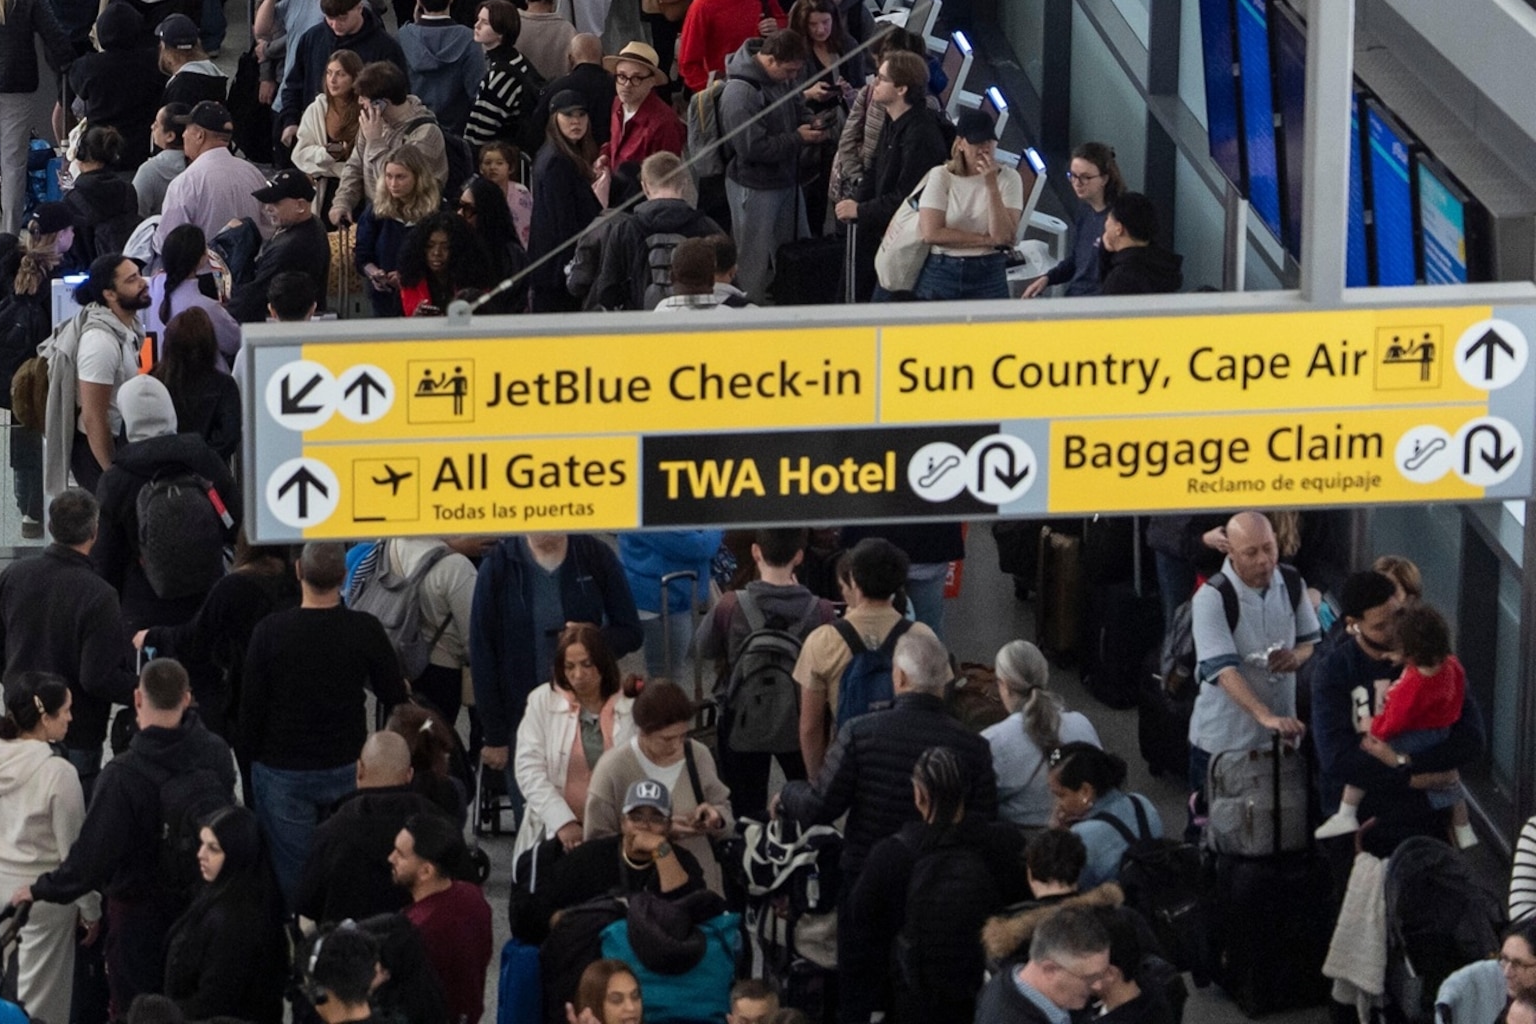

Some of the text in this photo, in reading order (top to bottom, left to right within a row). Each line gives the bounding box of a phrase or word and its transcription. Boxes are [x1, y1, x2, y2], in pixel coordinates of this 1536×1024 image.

[487, 359, 862, 408] JetBlue Check-in
[898, 338, 1369, 394] Sun Country, Cape Air
[432, 453, 628, 492] All Gates
[1063, 423, 1385, 479] Baggage Claim
[659, 450, 896, 502] TWA Hotel
[1187, 472, 1383, 495] Reclamo de equipaje
[432, 499, 595, 522] Todas las puertas
